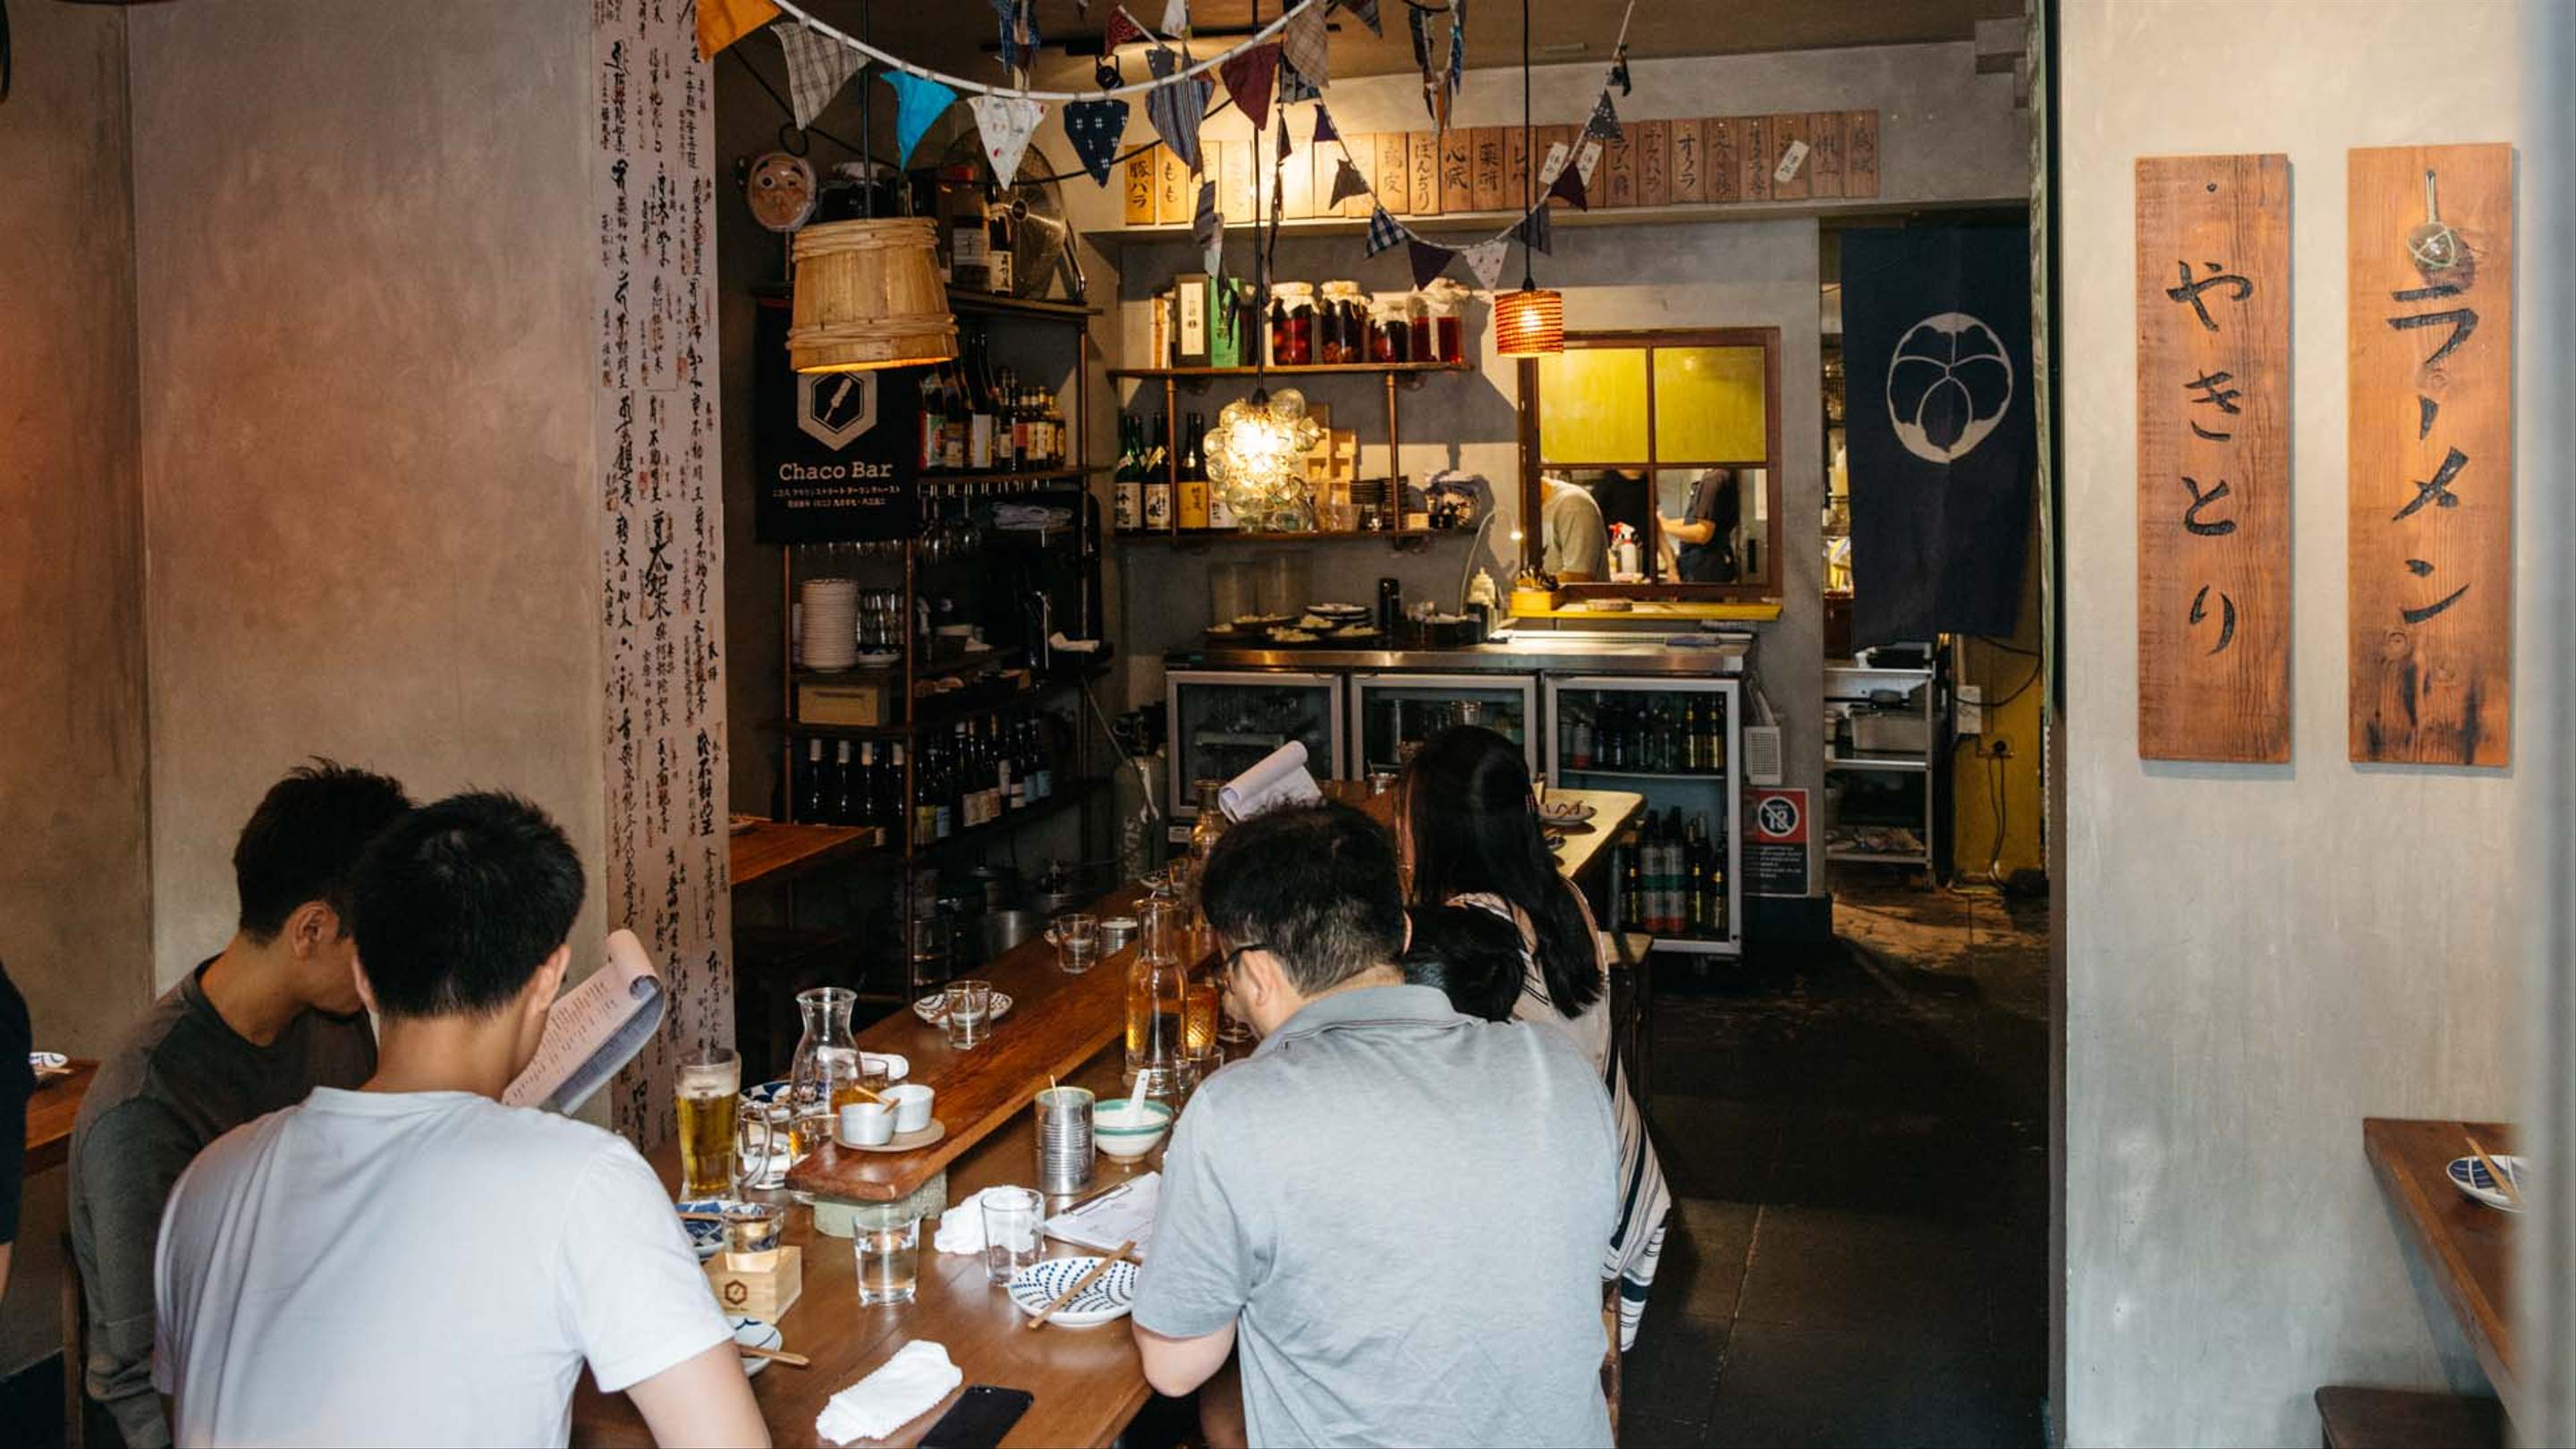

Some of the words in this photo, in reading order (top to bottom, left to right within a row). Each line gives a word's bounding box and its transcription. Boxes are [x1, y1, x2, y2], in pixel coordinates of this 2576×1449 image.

[1165, 162, 1179, 203] もも
[1677, 132, 1697, 191] オクラ
[778, 462, 846, 480] Chaco
[852, 461, 894, 479] Bar
[2165, 259, 2254, 657] やきとり
[2385, 284, 2479, 624] ラーメン
